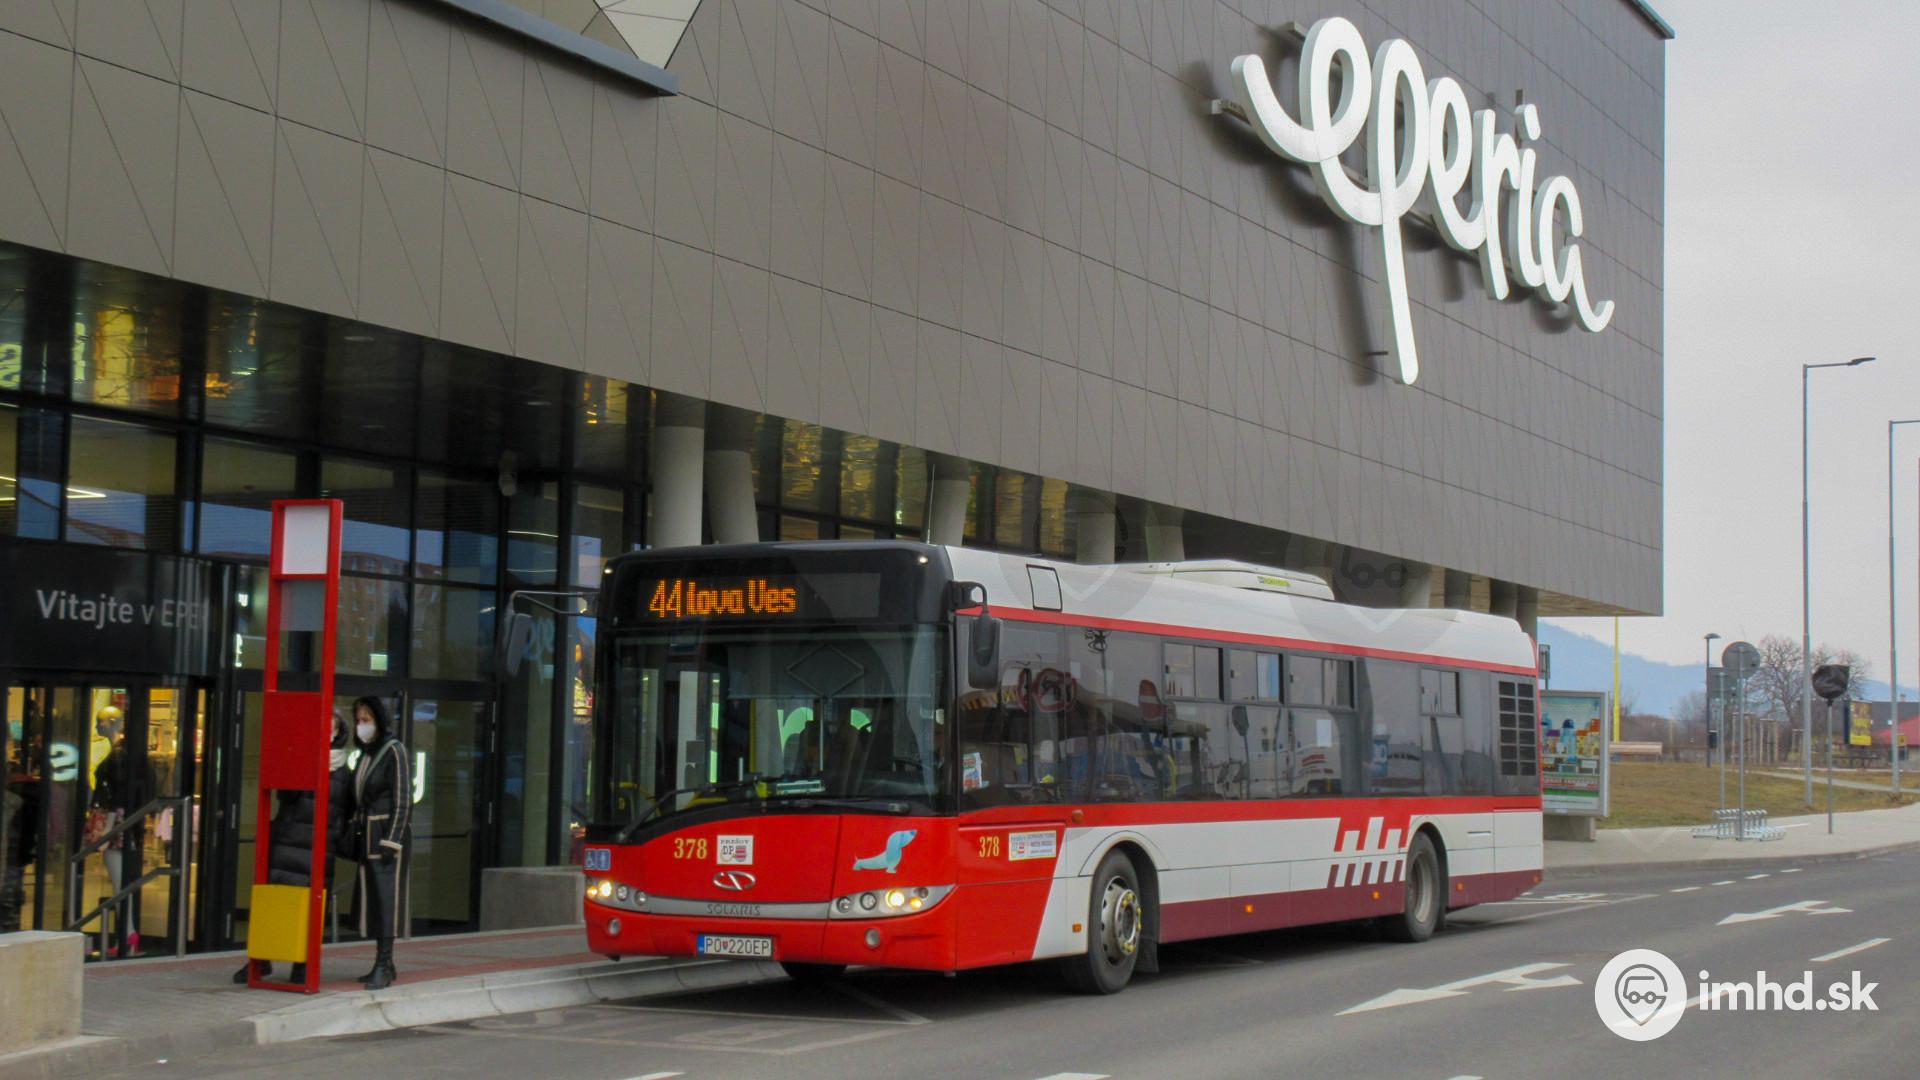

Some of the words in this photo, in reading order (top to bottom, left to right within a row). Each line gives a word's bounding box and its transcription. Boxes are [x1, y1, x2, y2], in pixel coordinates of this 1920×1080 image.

[1230, 16, 1615, 384] eperia
[36, 589, 134, 630] Vitajte
[141, 604, 155, 625] v
[161, 599, 209, 629] EPE
[650, 580, 682, 618] 44
[748, 579, 797, 613] Ves
[673, 838, 708, 860] 378
[722, 845, 734, 855] DP
[979, 836, 1000, 858] 378
[705, 903, 761, 916] SOLARIS
